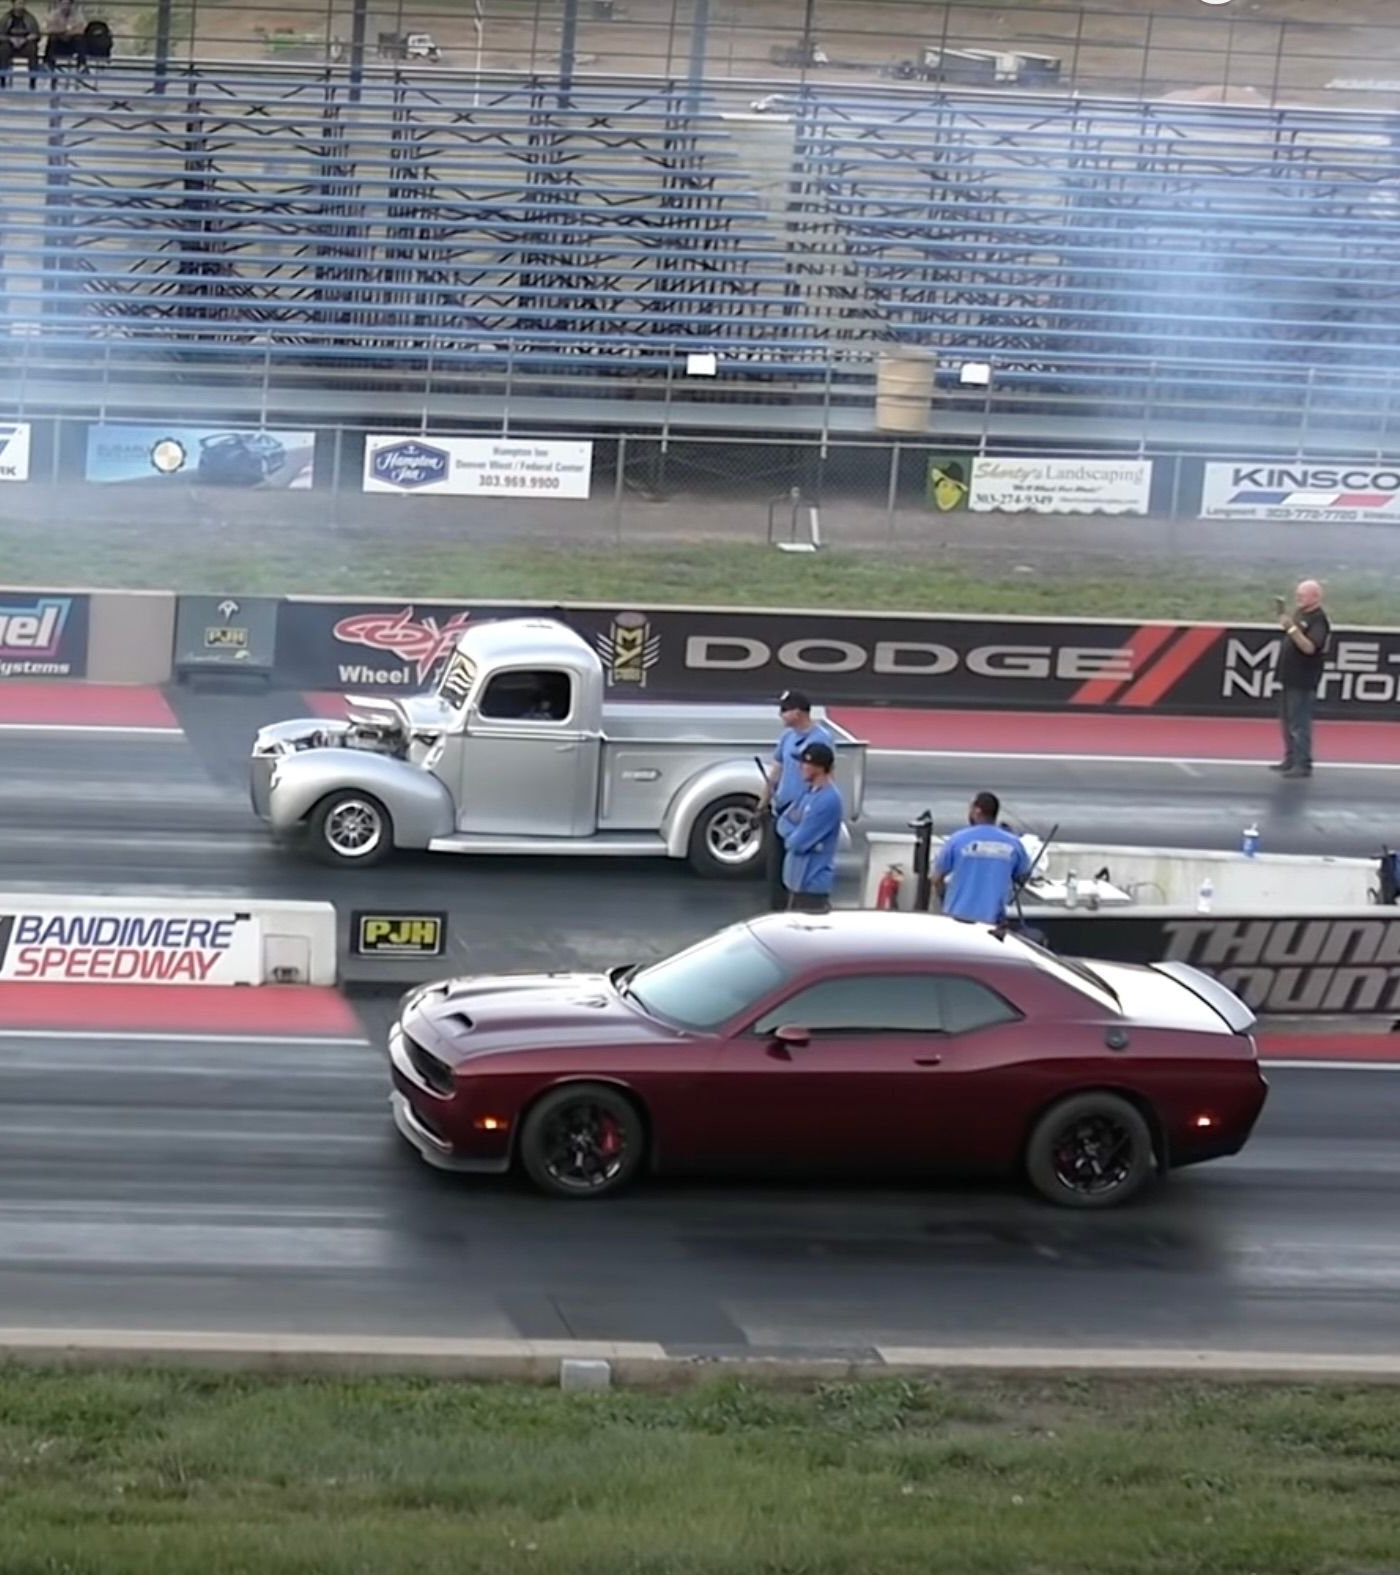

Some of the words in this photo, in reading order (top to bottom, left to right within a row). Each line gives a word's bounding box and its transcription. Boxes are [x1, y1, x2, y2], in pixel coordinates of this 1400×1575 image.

[1232, 469, 1400, 491] KINSCO
[685, 635, 1134, 680] DODGE
[339, 665, 410, 684] Wheel
[15, 915, 237, 948] BANDIMERE
[365, 920, 435, 945] PJH
[14, 947, 222, 979] SPEEDWAY
